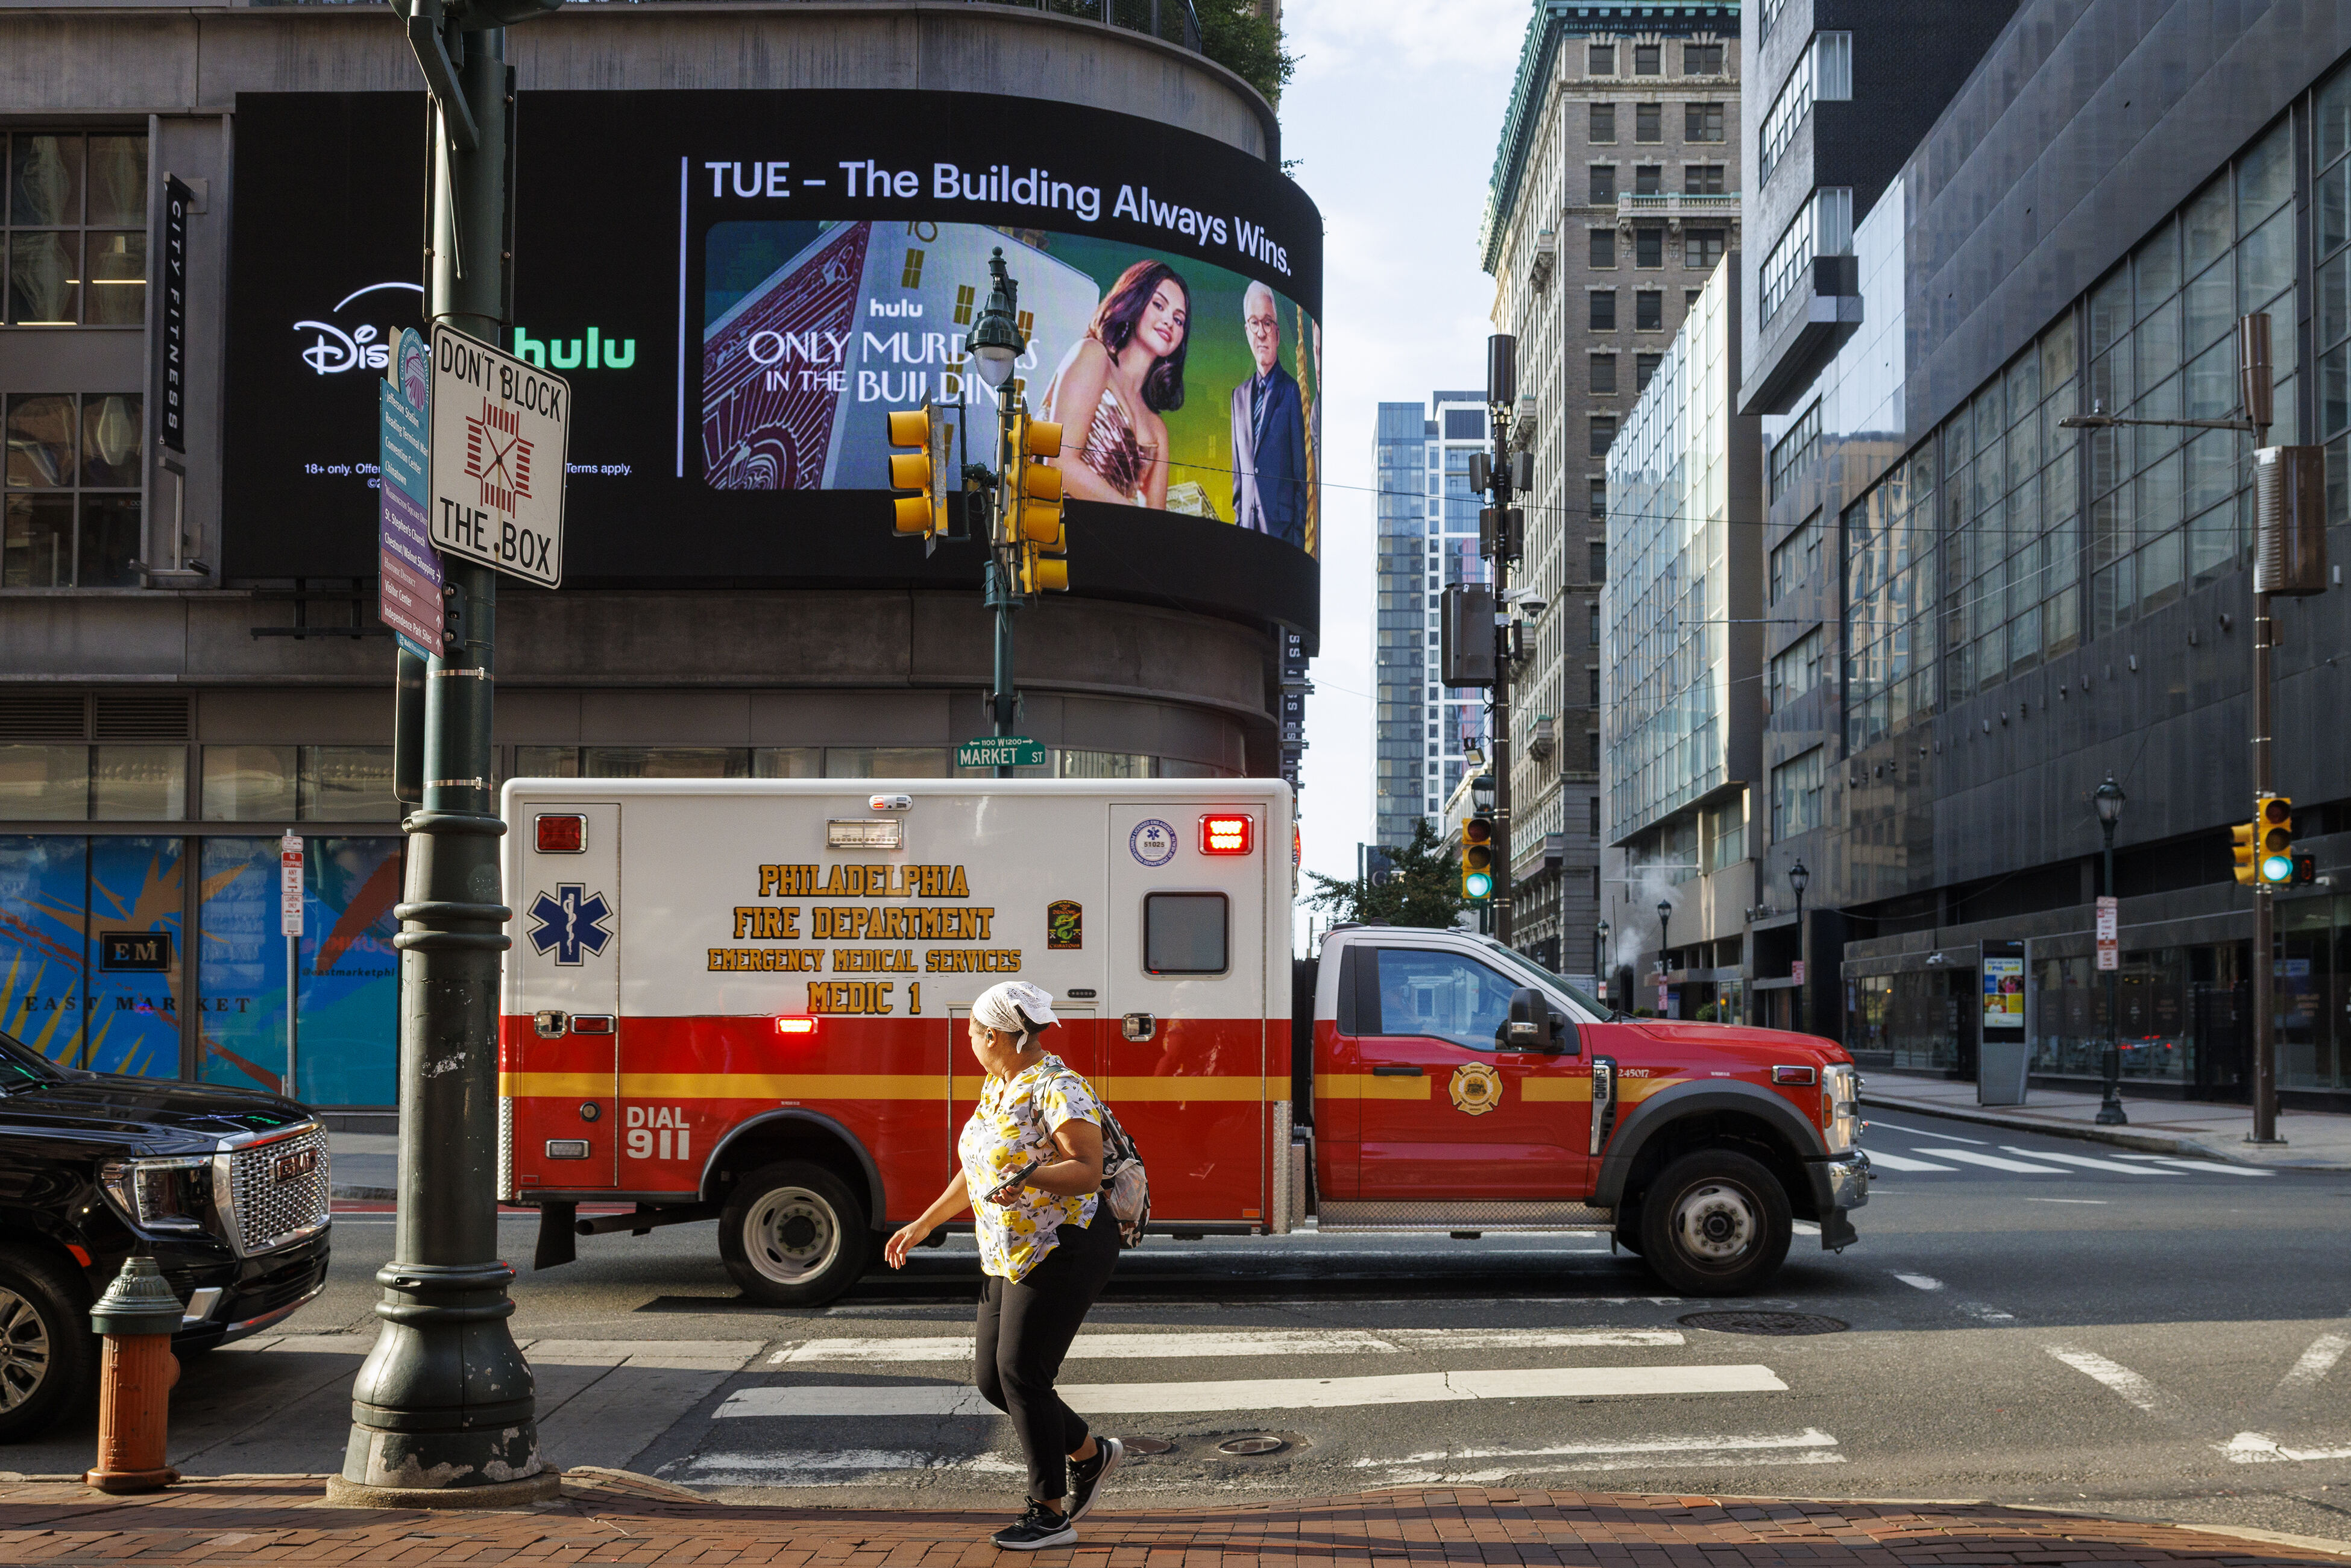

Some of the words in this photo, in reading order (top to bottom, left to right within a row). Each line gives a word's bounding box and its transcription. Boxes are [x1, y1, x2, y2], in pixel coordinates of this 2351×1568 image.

[705, 162, 790, 198] TUE
[839, 159, 919, 198] The
[934, 163, 1101, 221] Building
[1113, 184, 1227, 246] Always
[1235, 216, 1291, 277] Wins.
[171, 200, 181, 276] CITY
[870, 298, 923, 317] hulu
[168, 287, 180, 429] FITNESS
[293, 320, 389, 375] Dis
[514, 327, 635, 369] hulu
[748, 330, 852, 364] ONLY
[863, 331, 1040, 370] MURDS
[441, 336, 495, 392] DON'T
[501, 367, 562, 423] BLOCK
[766, 371, 789, 391] IN
[799, 371, 848, 392] THE
[386, 389, 404, 414] Jefferson
[404, 407, 419, 428] Station
[385, 412, 402, 437] Reading
[402, 426, 420, 450] Terminal
[304, 463, 325, 474] 18+
[327, 463, 351, 476] only.
[566, 462, 598, 474] Terms
[601, 463, 632, 476] apply.
[385, 436, 408, 464] Convention
[408, 455, 421, 475] Center
[385, 460, 407, 486] Chinatown
[392, 514, 411, 537] Stephen's
[411, 531, 426, 547] Church
[439, 497, 488, 553] THE
[502, 520, 552, 576] BOX
[385, 532, 417, 566] Chestnut/Walnut
[417, 559, 435, 580] Shopping
[385, 579, 398, 598] Visitor
[398, 590, 412, 607] Center
[385, 605, 412, 631] Independence
[412, 626, 422, 639] Park
[422, 629, 432, 644] Sites
[960, 748, 1018, 765] MARKET
[1031, 752, 1043, 763] ST
[998, 738, 1005, 747] W
[758, 864, 970, 898] PHILADELPHIA
[733, 907, 800, 939] FIRE
[812, 907, 995, 940] DEPARTMENT
[113, 941, 159, 961] EM
[707, 948, 825, 972] EMERGENCY
[832, 949, 919, 973] MEDICAL
[925, 949, 1022, 973] SERVICES
[25, 997, 98, 1012] EAST
[116, 997, 250, 1013] MARKET
[807, 982, 893, 1015] MEDIC
[908, 982, 921, 1015] 1
[1618, 1069, 1649, 1078] 245017
[627, 1106, 690, 1129] DIAL
[627, 1129, 690, 1160] 911
[277, 1150, 317, 1179] GMC
